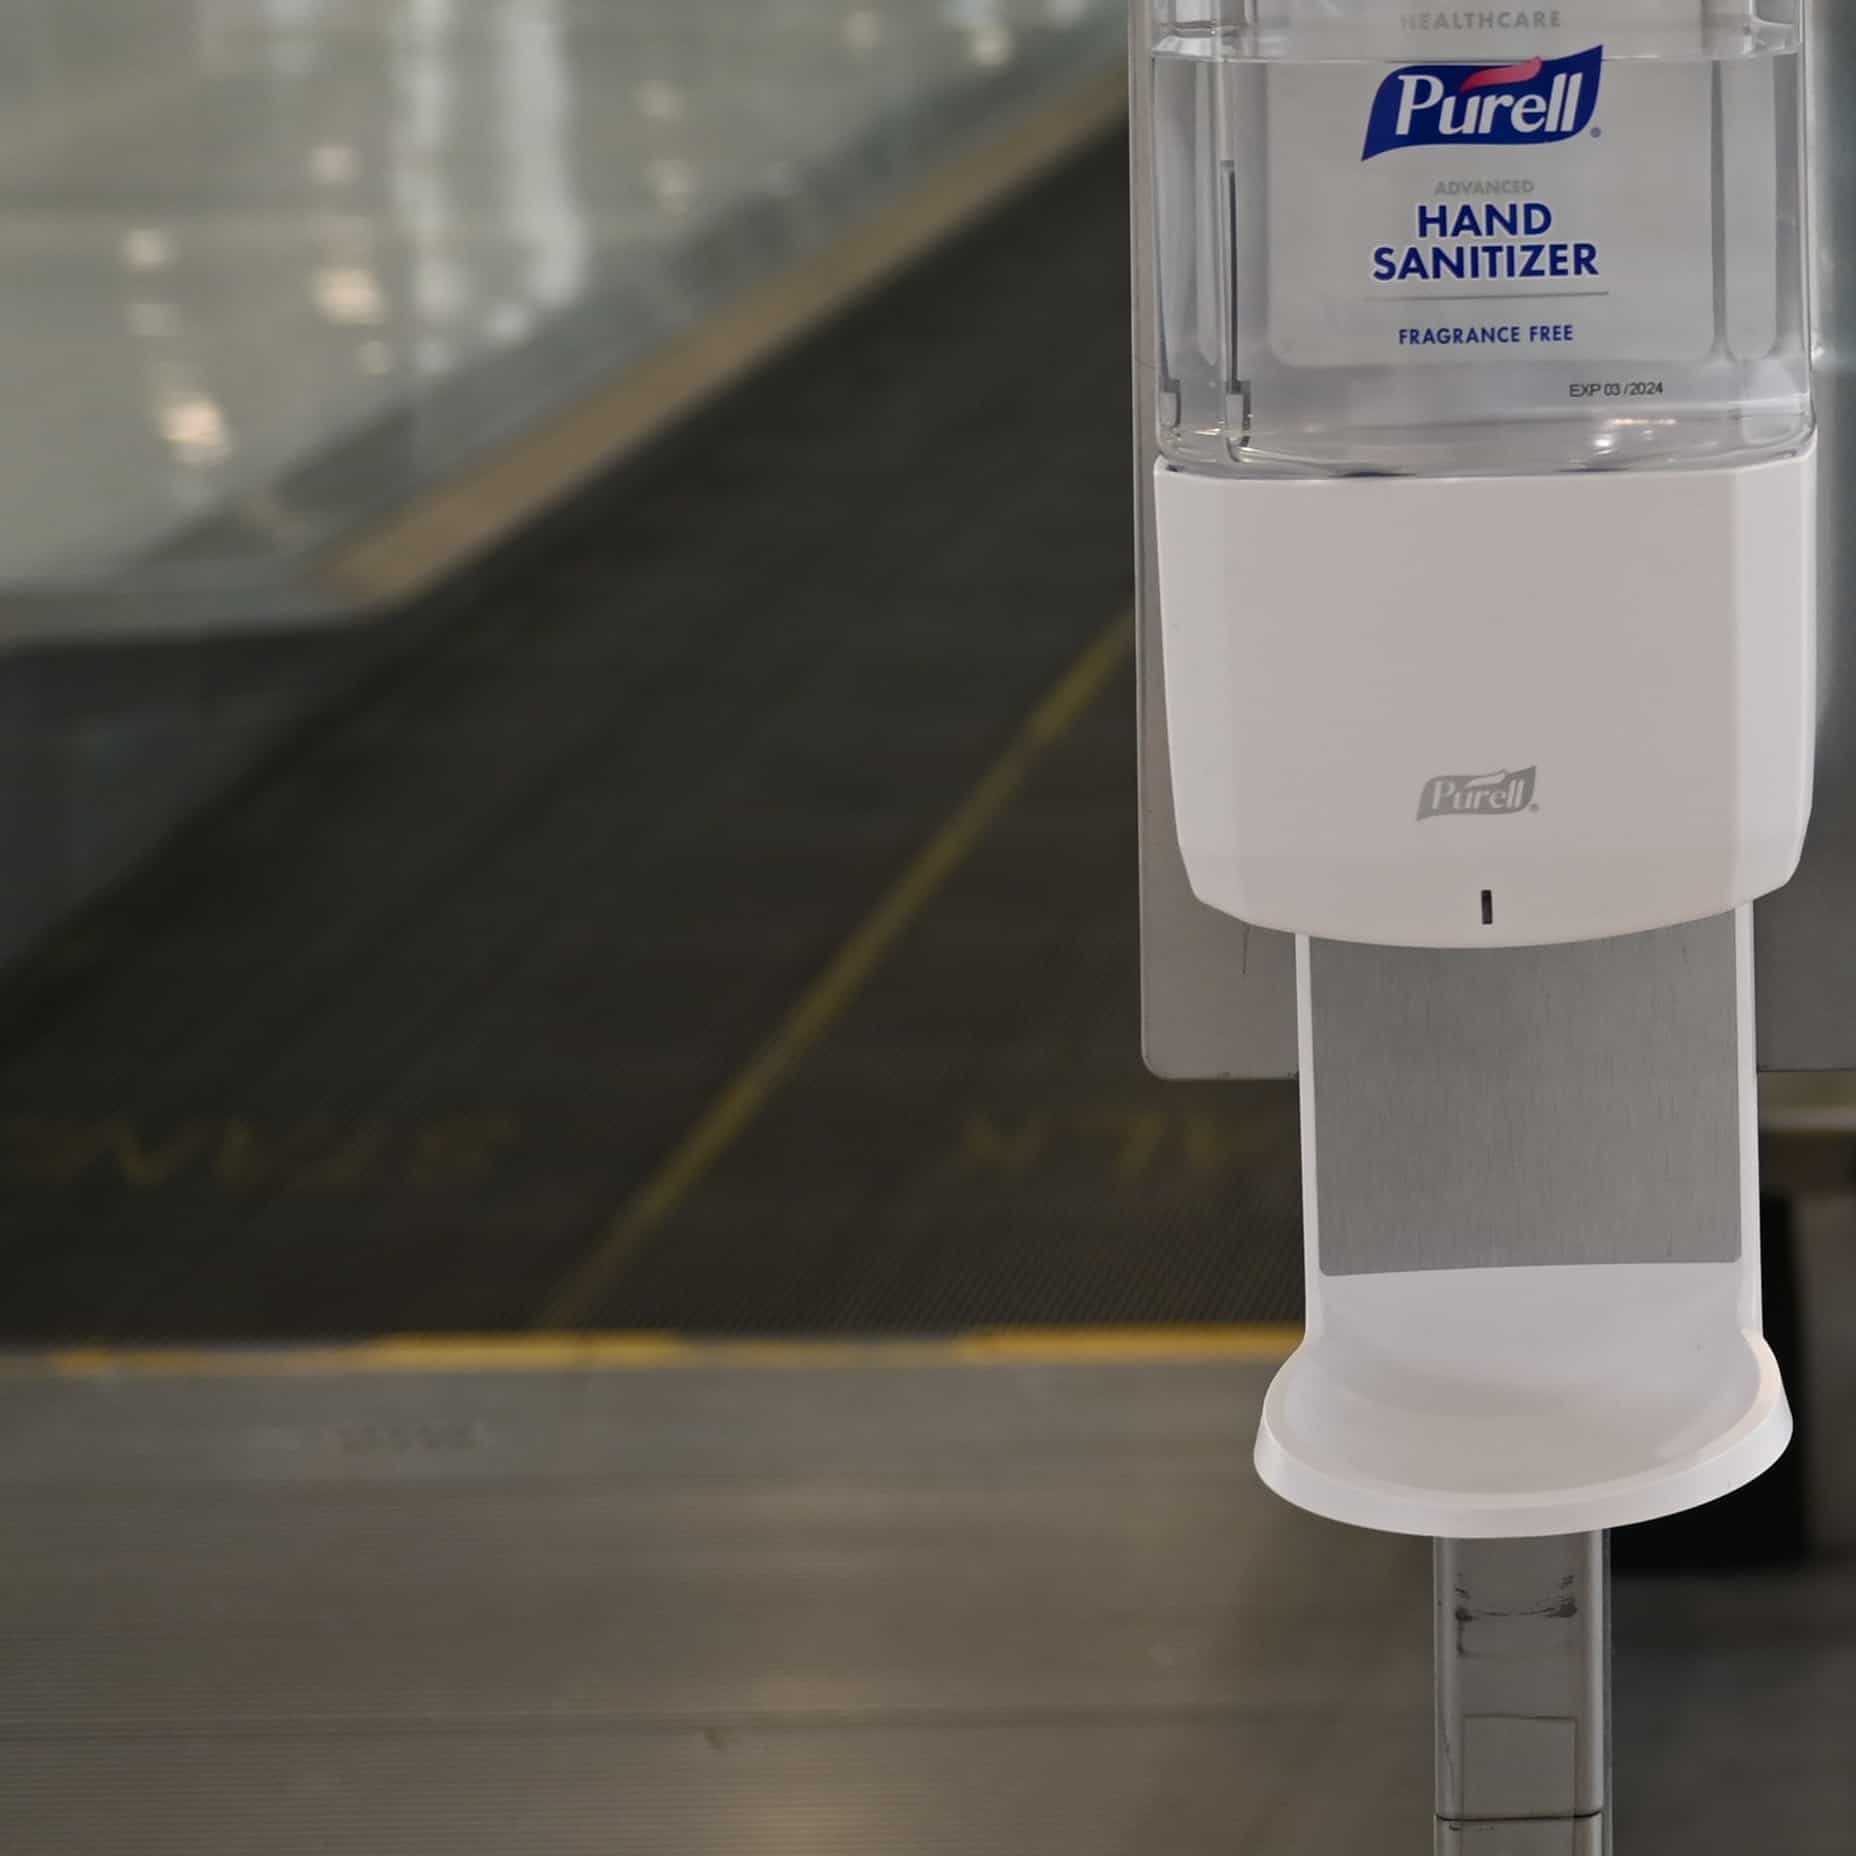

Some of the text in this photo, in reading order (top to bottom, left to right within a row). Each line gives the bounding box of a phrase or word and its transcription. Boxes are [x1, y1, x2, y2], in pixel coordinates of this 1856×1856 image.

[1402, 9, 1562, 31] HEALTHCARE
[1434, 179, 1535, 196] ADVANCED
[1417, 201, 1553, 239] HAND
[1372, 242, 1600, 282] SANITIZER
[1398, 324, 1574, 345] FRAGRANCE FREE
[1568, 383, 1601, 398] EXP
